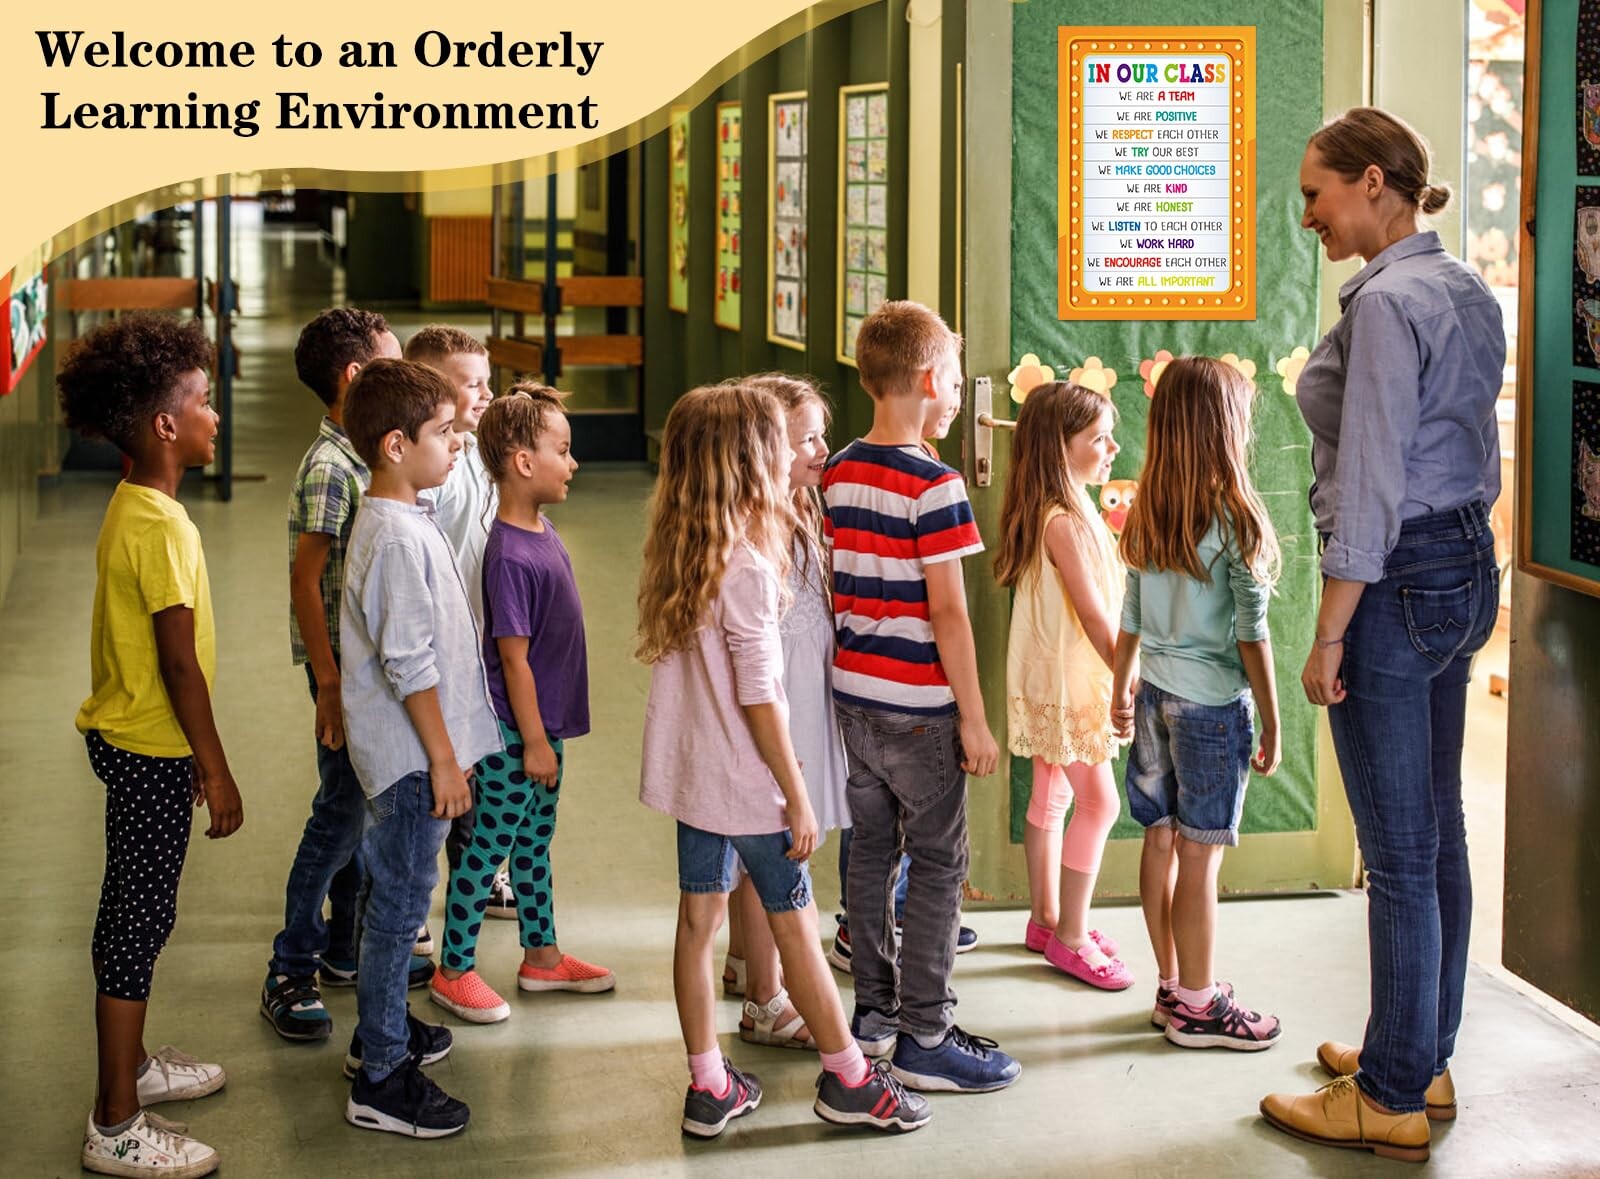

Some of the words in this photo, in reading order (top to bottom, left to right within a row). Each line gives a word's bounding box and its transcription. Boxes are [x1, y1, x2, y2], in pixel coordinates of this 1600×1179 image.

[1088, 64, 1110, 83] IN
[1117, 64, 1158, 83] OUR
[1164, 64, 1226, 83] CLASS
[1118, 91, 1132, 101] WE
[1135, 91, 1154, 101] ARE
[1157, 90, 1166, 102] A
[1167, 90, 1195, 102] TEAM
[1116, 111, 1130, 121] WE
[1133, 111, 1152, 121] ARE
[1155, 110, 1198, 122] POSITIVE
[1095, 129, 1108, 140] WE
[1111, 129, 1154, 140] RESPECT
[1157, 129, 1184, 140] EACH
[1186, 129, 1219, 140] OTHER
[1114, 147, 1128, 157] WE
[1130, 146, 1150, 158] TRY
[1152, 146, 1173, 158] OUR
[1175, 146, 1199, 158] BEST
[1098, 165, 1112, 175] WE
[1115, 164, 1143, 176] MAKE
[1145, 164, 1173, 176] GOOD
[1173, 164, 1216, 176] CHOICES
[1126, 183, 1140, 194] WE
[1143, 183, 1162, 194] ARE
[1165, 183, 1188, 194] KIND
[1116, 202, 1130, 212] WE
[1133, 202, 1153, 212] ARE
[1155, 201, 1194, 213] HONEST
[1091, 221, 1105, 231] WE
[1108, 220, 1141, 232] LISTEN
[1144, 220, 1158, 232] TO
[1160, 220, 1188, 232] EACH
[1190, 220, 1223, 232] OTHER
[1119, 238, 1133, 249] WE
[1136, 238, 1165, 250] WORK
[1167, 238, 1195, 250] HARD
[1087, 257, 1100, 268] WE
[1104, 256, 1162, 268] ENCOURAGE
[1165, 257, 1192, 268] EACH
[1194, 257, 1227, 268] OTHER
[1098, 276, 1112, 287] WE
[1115, 276, 1134, 287] ARE
[1137, 275, 1158, 287] ALL
[1160, 275, 1216, 287] IMPORTANT
